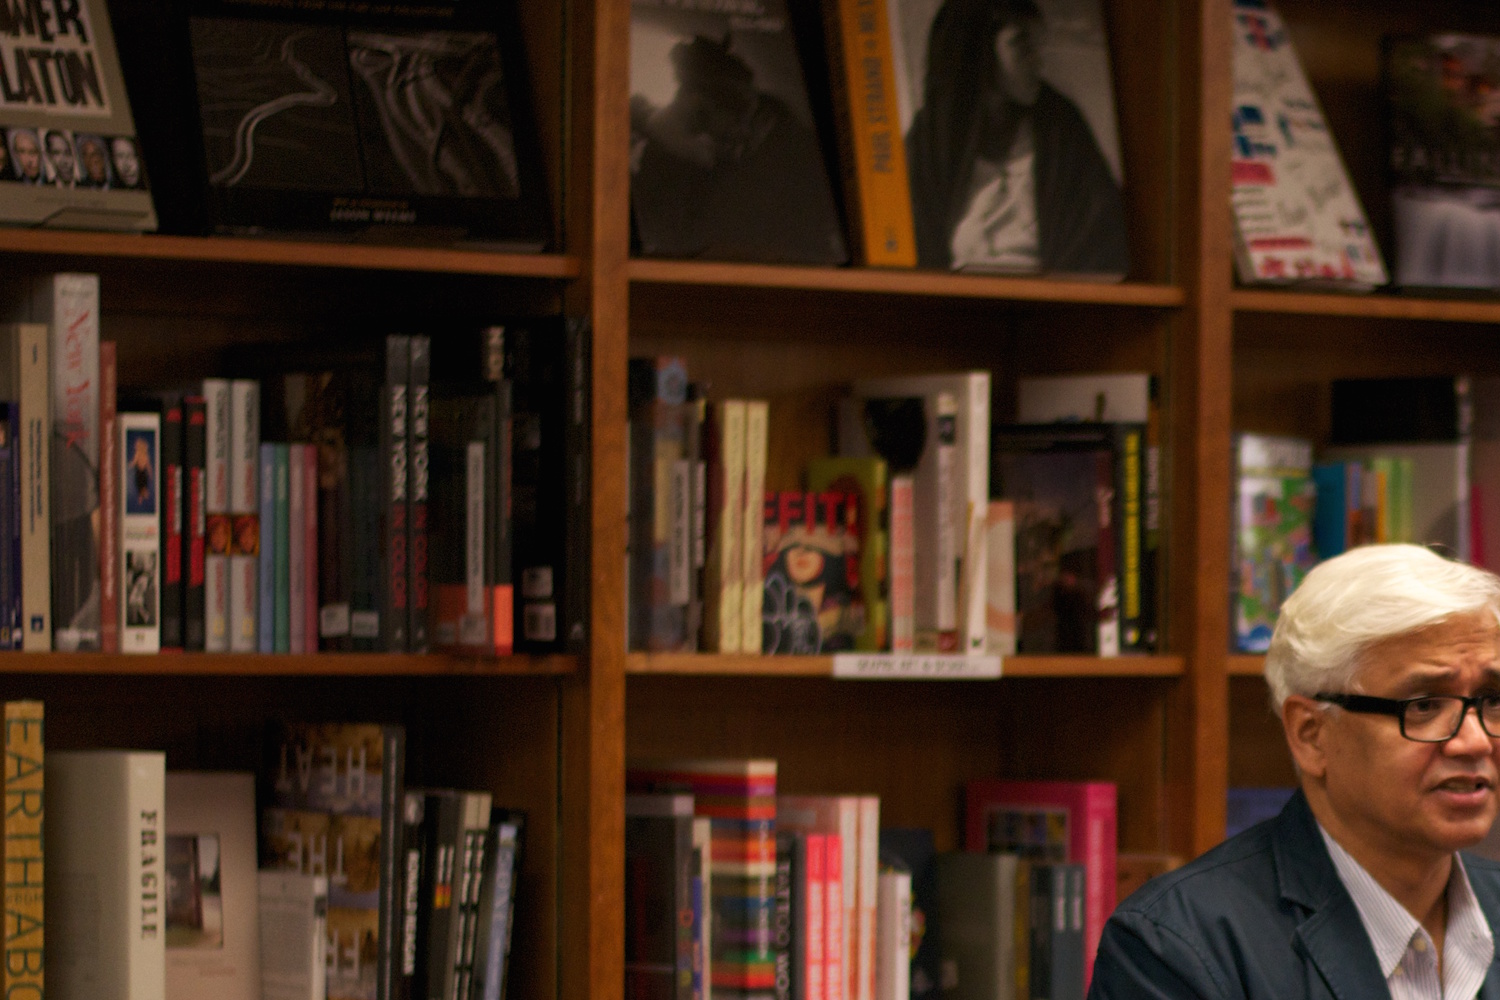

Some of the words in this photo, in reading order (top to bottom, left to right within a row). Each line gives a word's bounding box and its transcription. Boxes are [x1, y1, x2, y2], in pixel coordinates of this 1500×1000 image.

[391, 385, 407, 436] NEW
[413, 385, 430, 436] NEW
[391, 440, 407, 502] YORK
[413, 440, 430, 502] YORK
[392, 535, 408, 609] COLOR
[413, 535, 429, 609] COLOR
[5, 717, 44, 889] EARTH
[140, 809, 158, 940] FRAGILE
[776, 863, 790, 946] TATTOO
